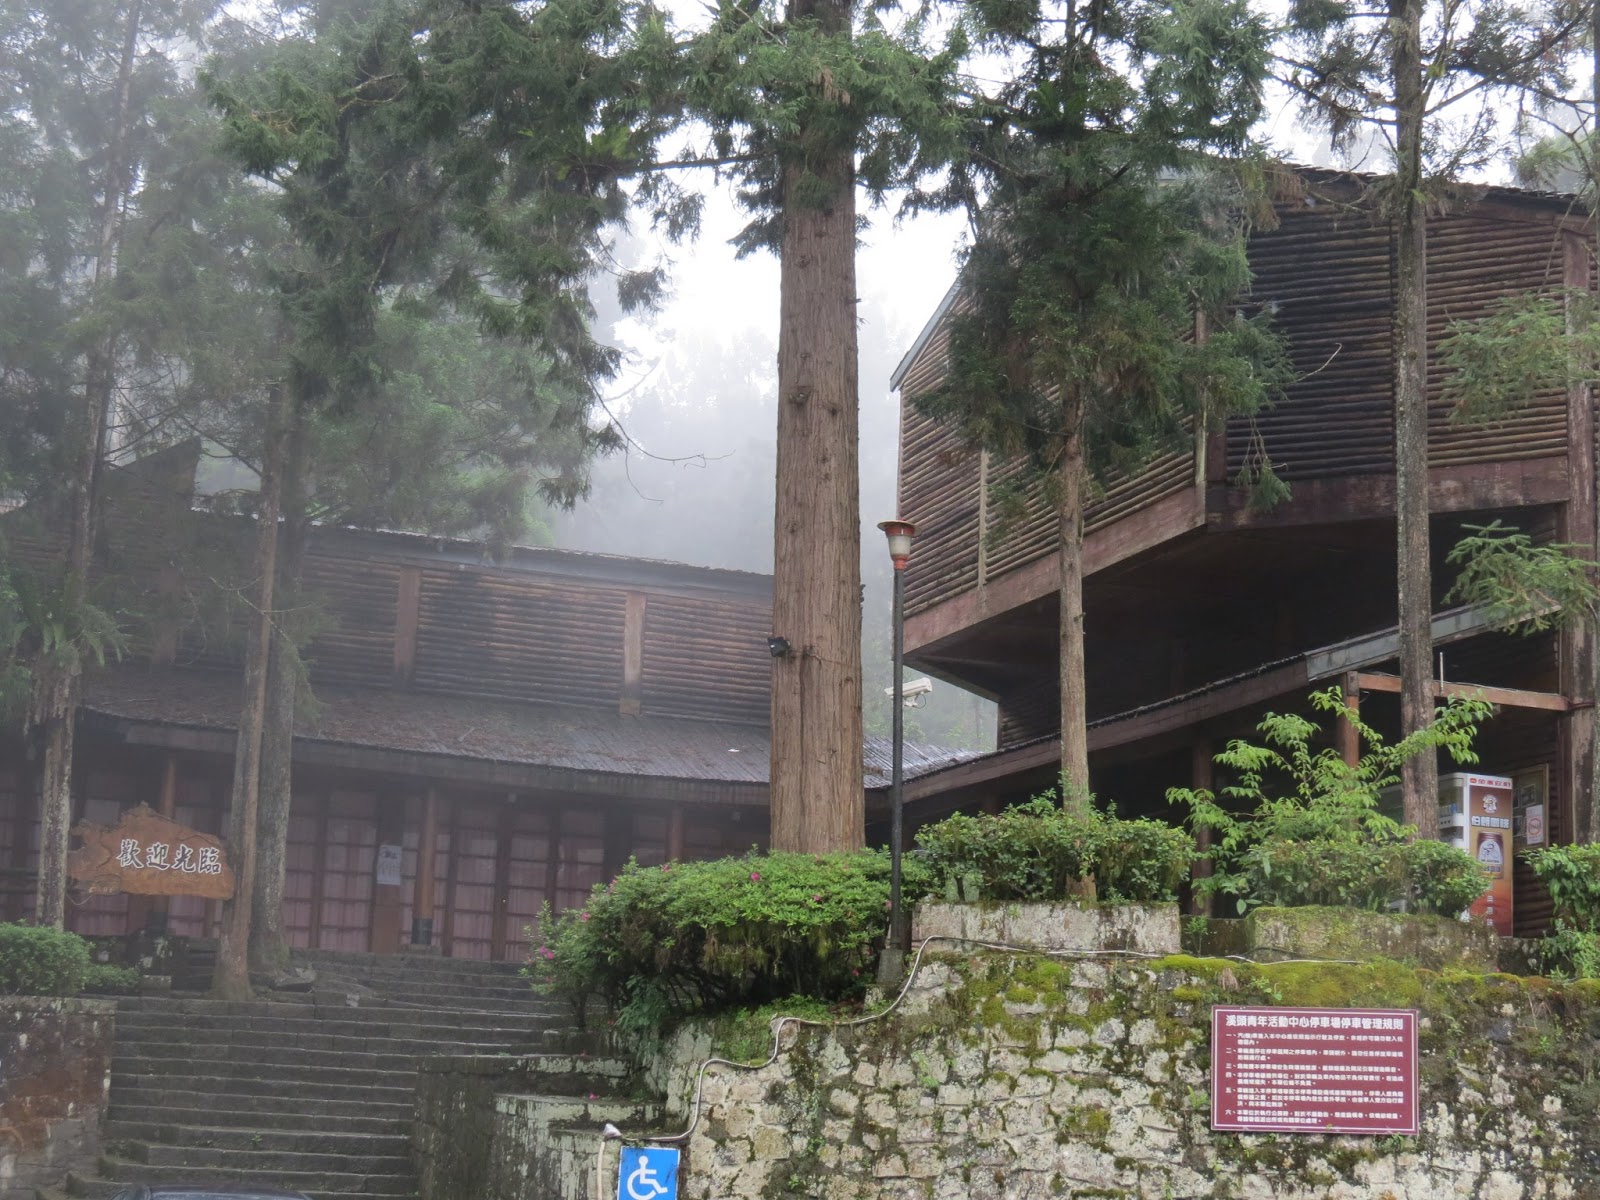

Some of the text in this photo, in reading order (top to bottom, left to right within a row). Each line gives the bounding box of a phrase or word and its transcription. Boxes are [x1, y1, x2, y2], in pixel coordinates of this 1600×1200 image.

[1471, 816, 1510, 829] 伯朗咖啡
[116, 839, 221, 875] 歡迎光臨
[1225, 1014, 1404, 1030] 溪頭青年活動中心停車場停車管理規則
